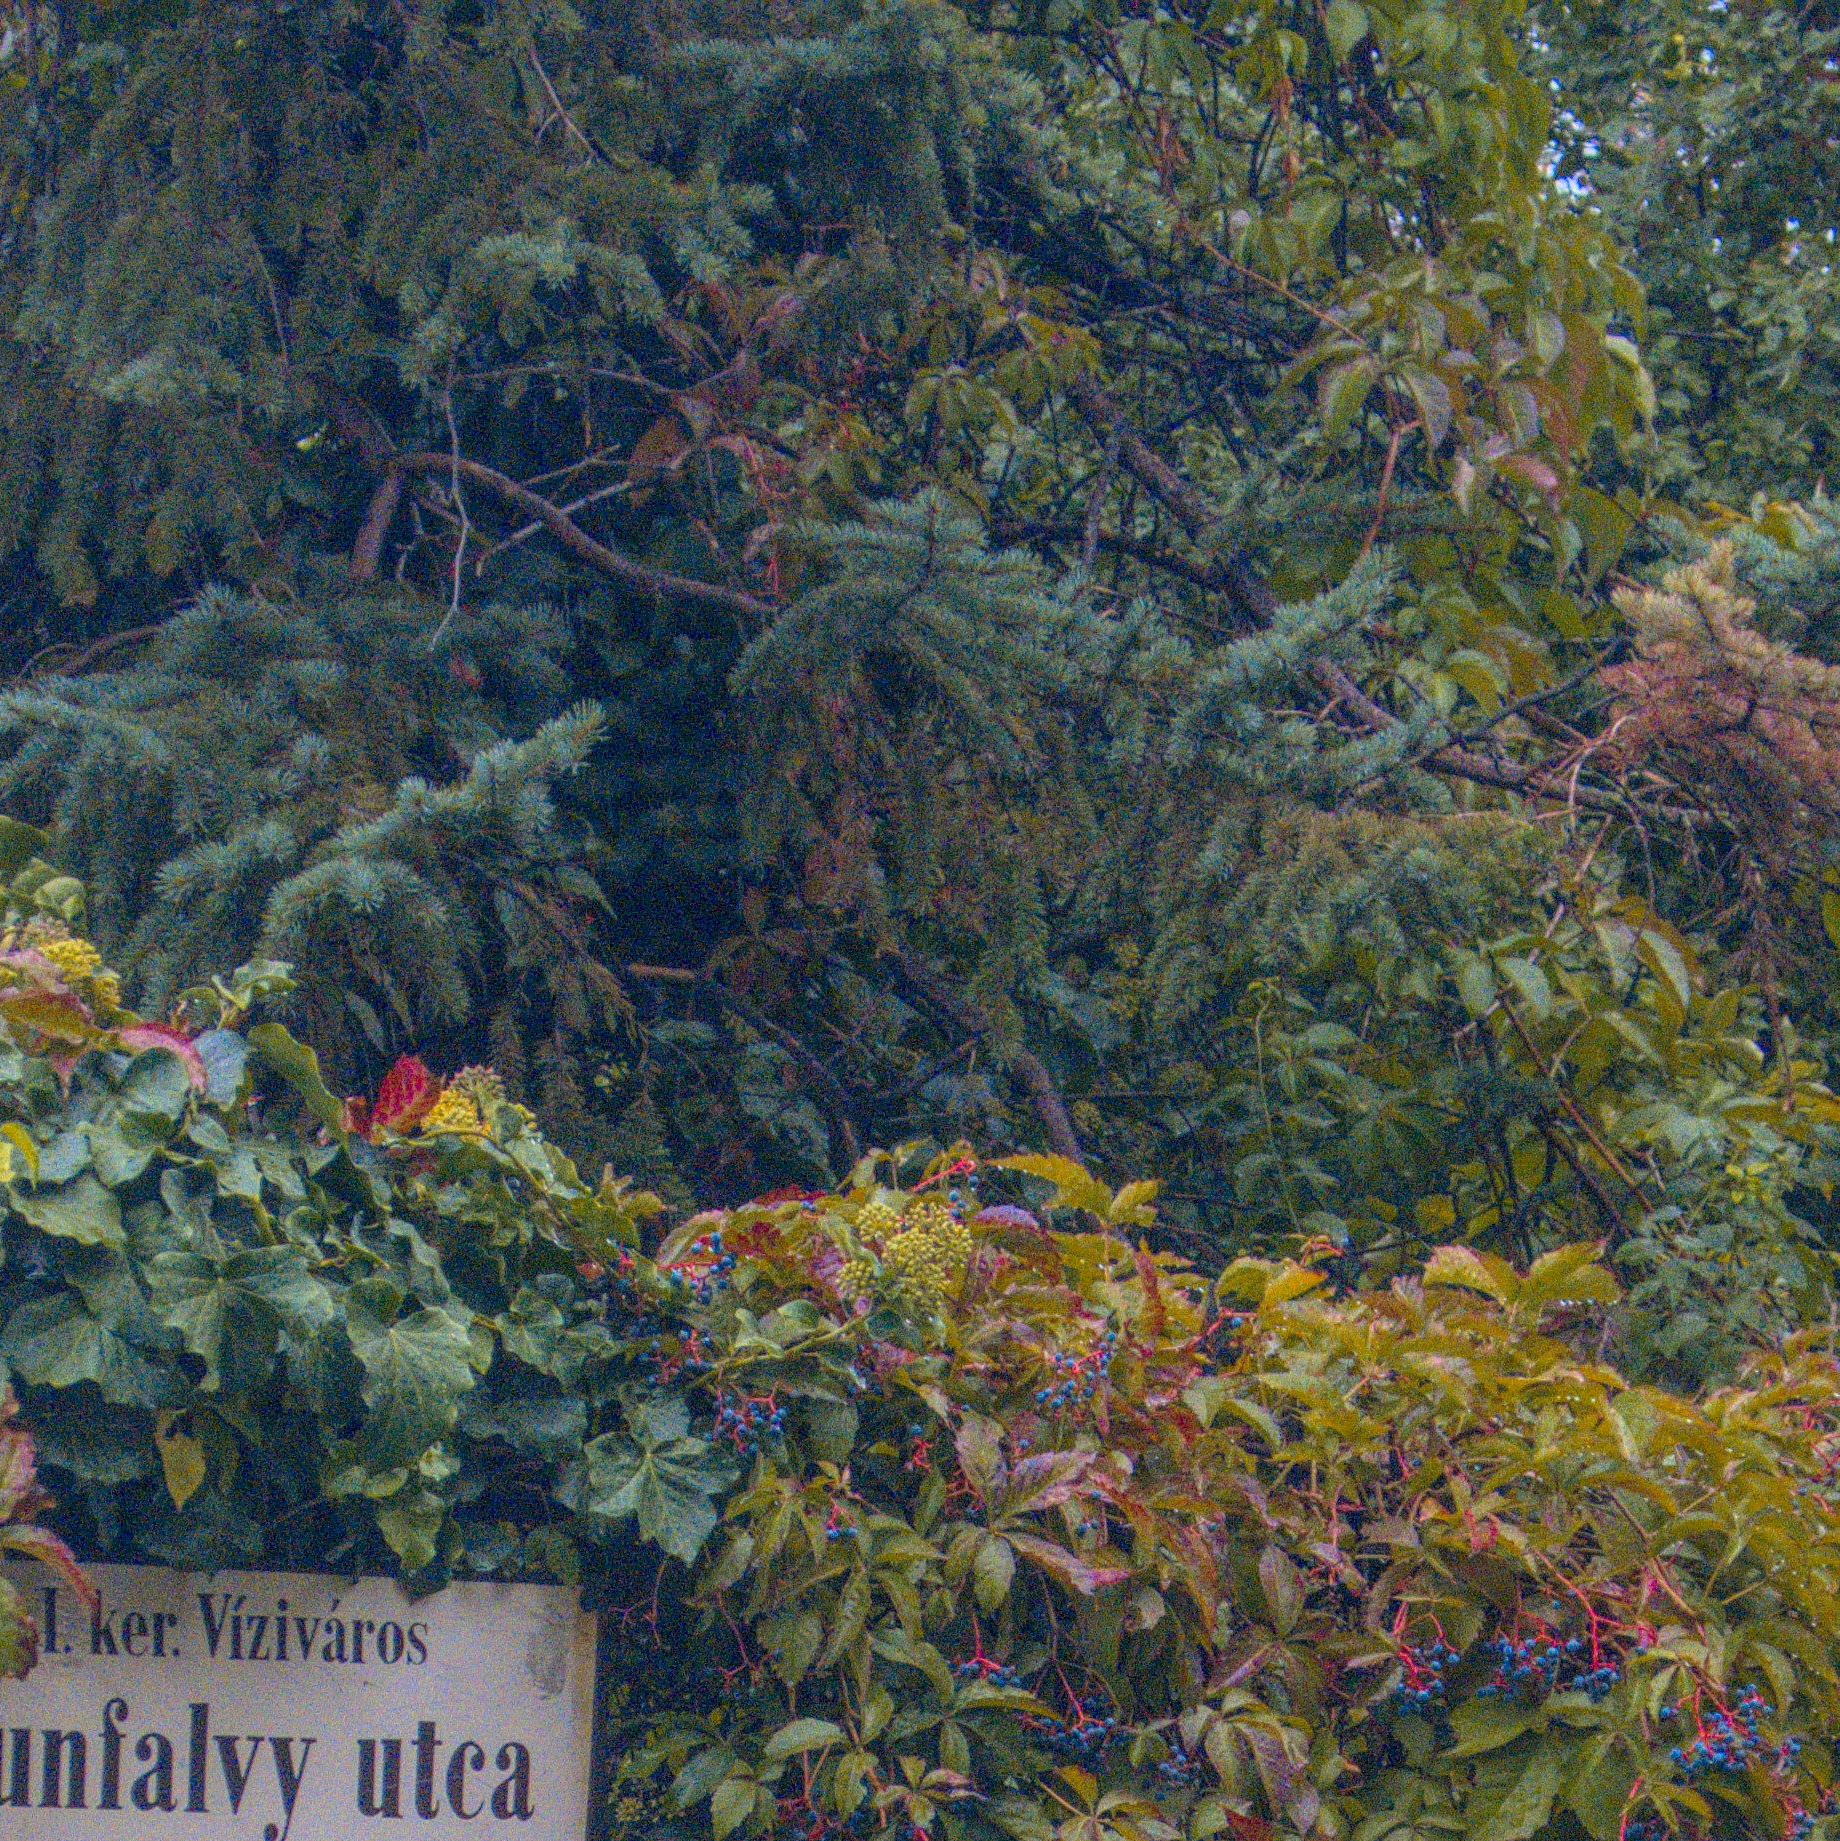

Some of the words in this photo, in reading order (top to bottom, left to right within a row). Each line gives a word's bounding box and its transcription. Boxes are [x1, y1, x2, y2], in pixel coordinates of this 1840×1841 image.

[40, 1587, 73, 1654] I.
[90, 1589, 178, 1659] ker.
[197, 1590, 429, 1667] Víziváros
[357, 1721, 535, 1822] utca
